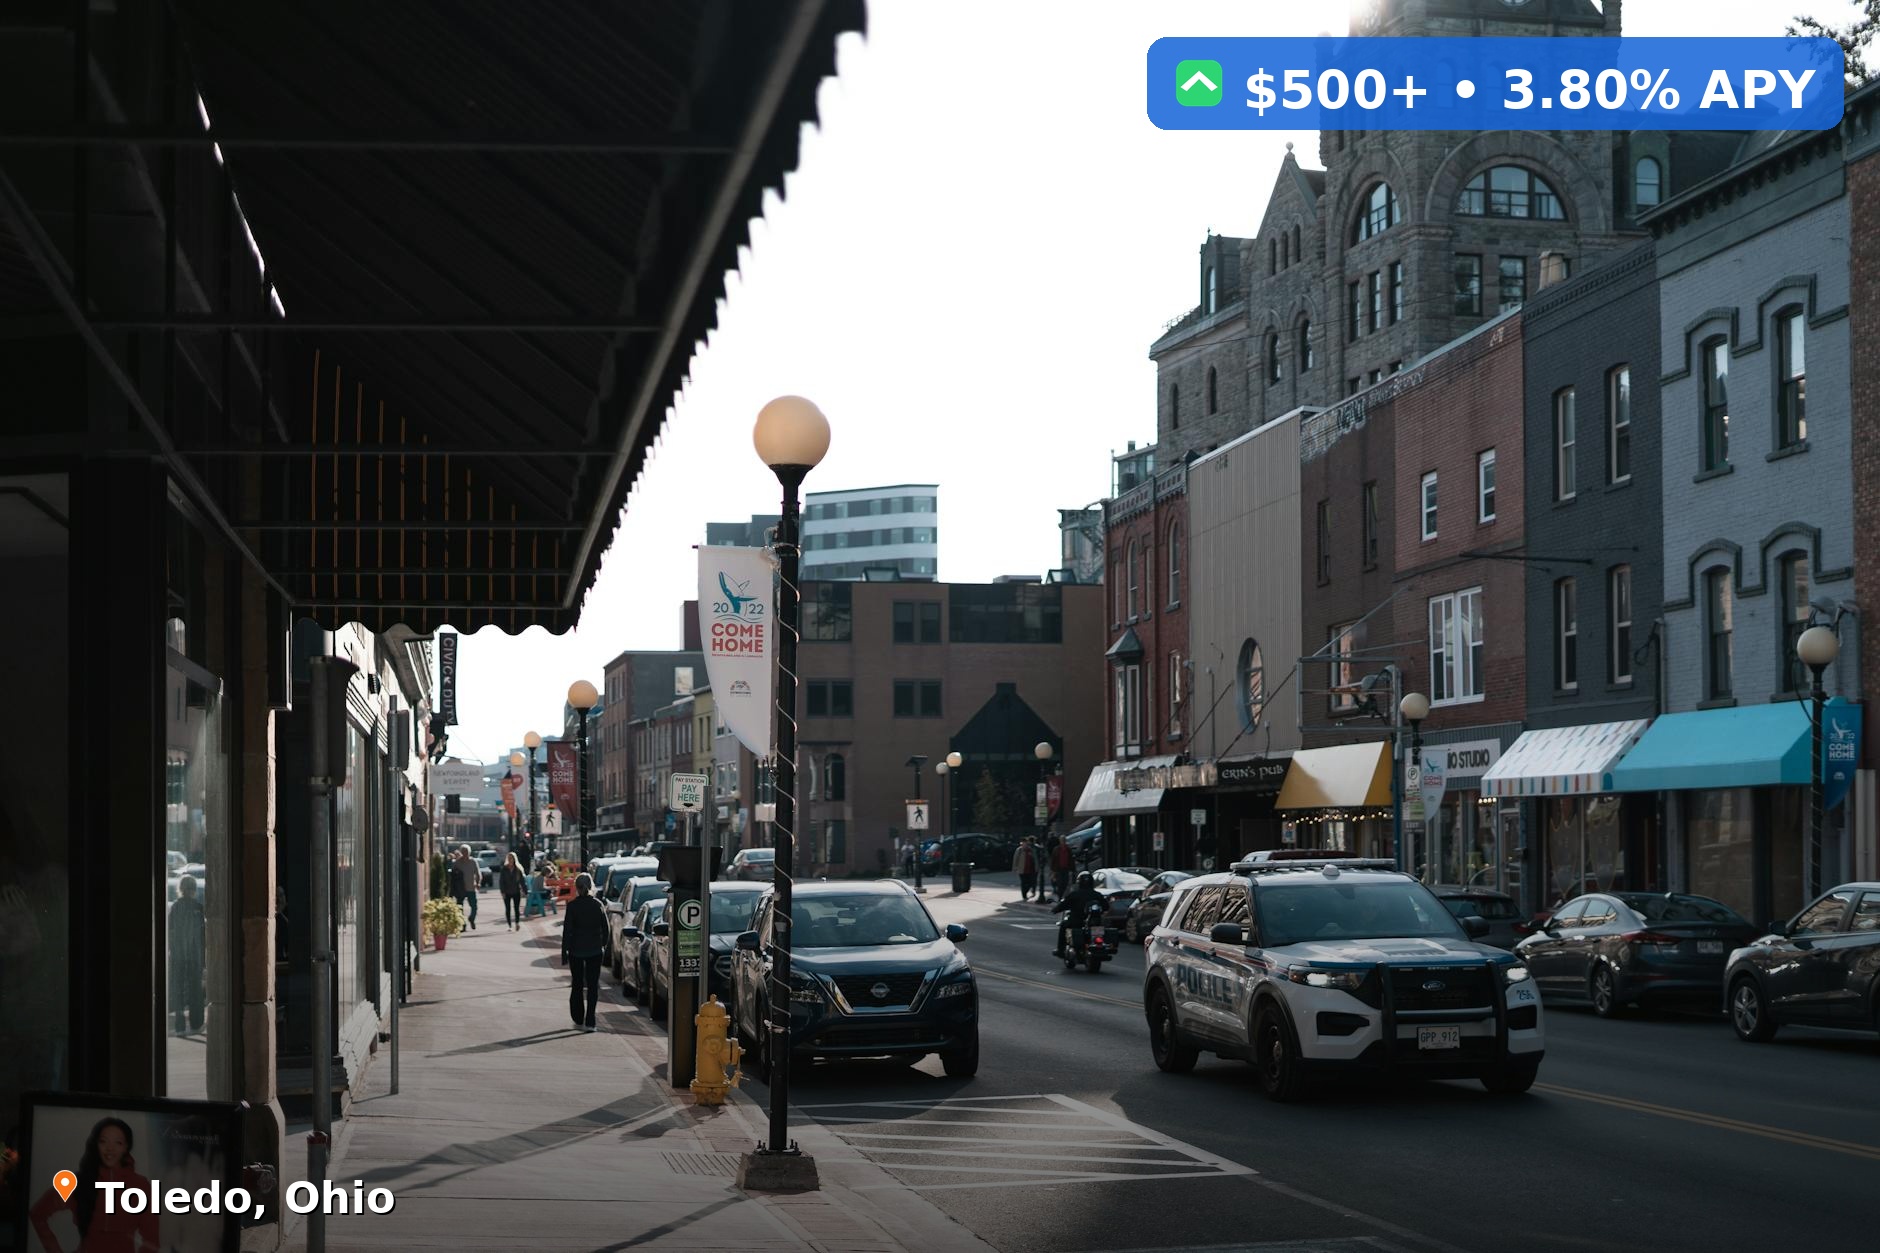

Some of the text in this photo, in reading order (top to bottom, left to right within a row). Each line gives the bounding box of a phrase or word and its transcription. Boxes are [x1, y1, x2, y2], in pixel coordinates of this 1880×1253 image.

[713, 602, 764, 615] 20 22
[711, 622, 764, 638] COME
[712, 638, 764, 653] HOME
[1828, 743, 1855, 751] COME
[1458, 748, 1490, 768] STUDIO
[1828, 751, 1856, 759] HOME
[681, 784, 697, 793] PAY
[677, 793, 700, 803] HERE
[687, 906, 700, 924] P
[1420, 1031, 1458, 1042] GPP 912
